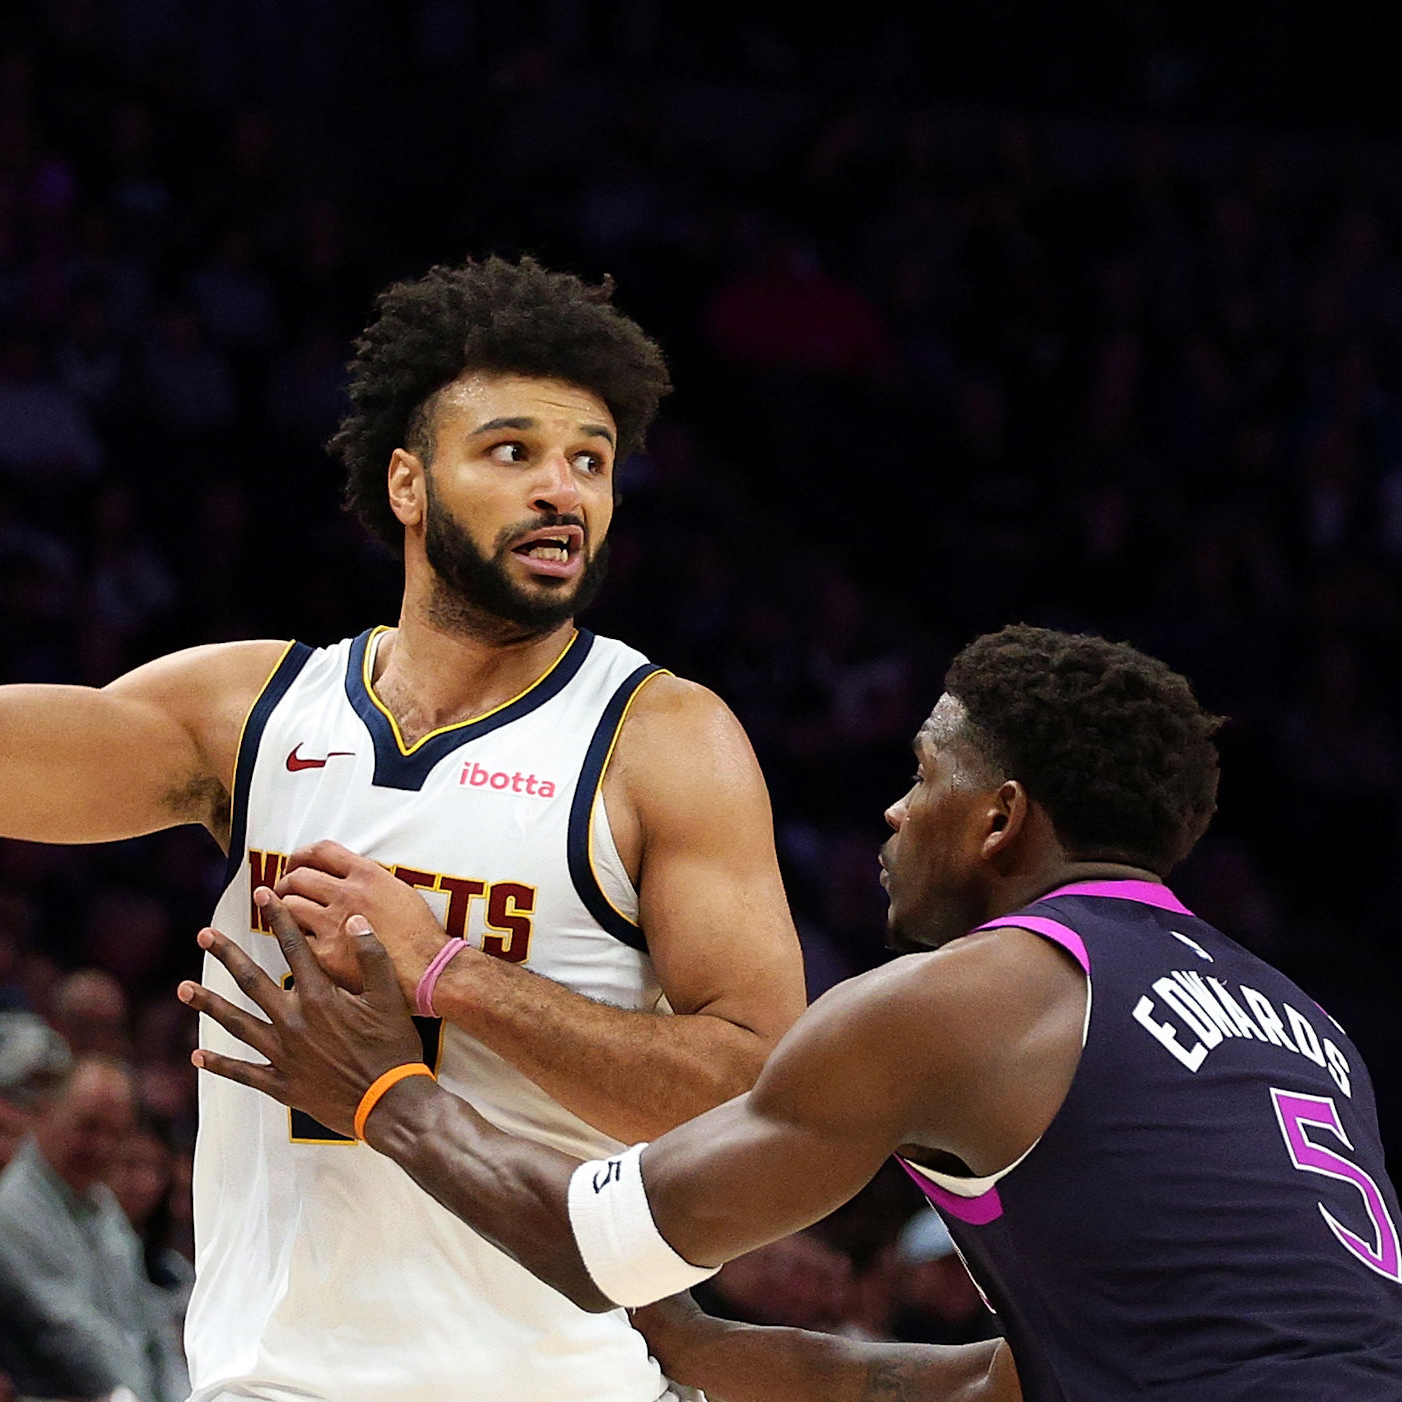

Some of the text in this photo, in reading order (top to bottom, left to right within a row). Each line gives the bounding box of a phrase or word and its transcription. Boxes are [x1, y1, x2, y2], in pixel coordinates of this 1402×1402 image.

[459, 761, 556, 798] ibotta
[1131, 970, 1351, 1099] EDWARDS
[1269, 1087, 1402, 1284] 5
